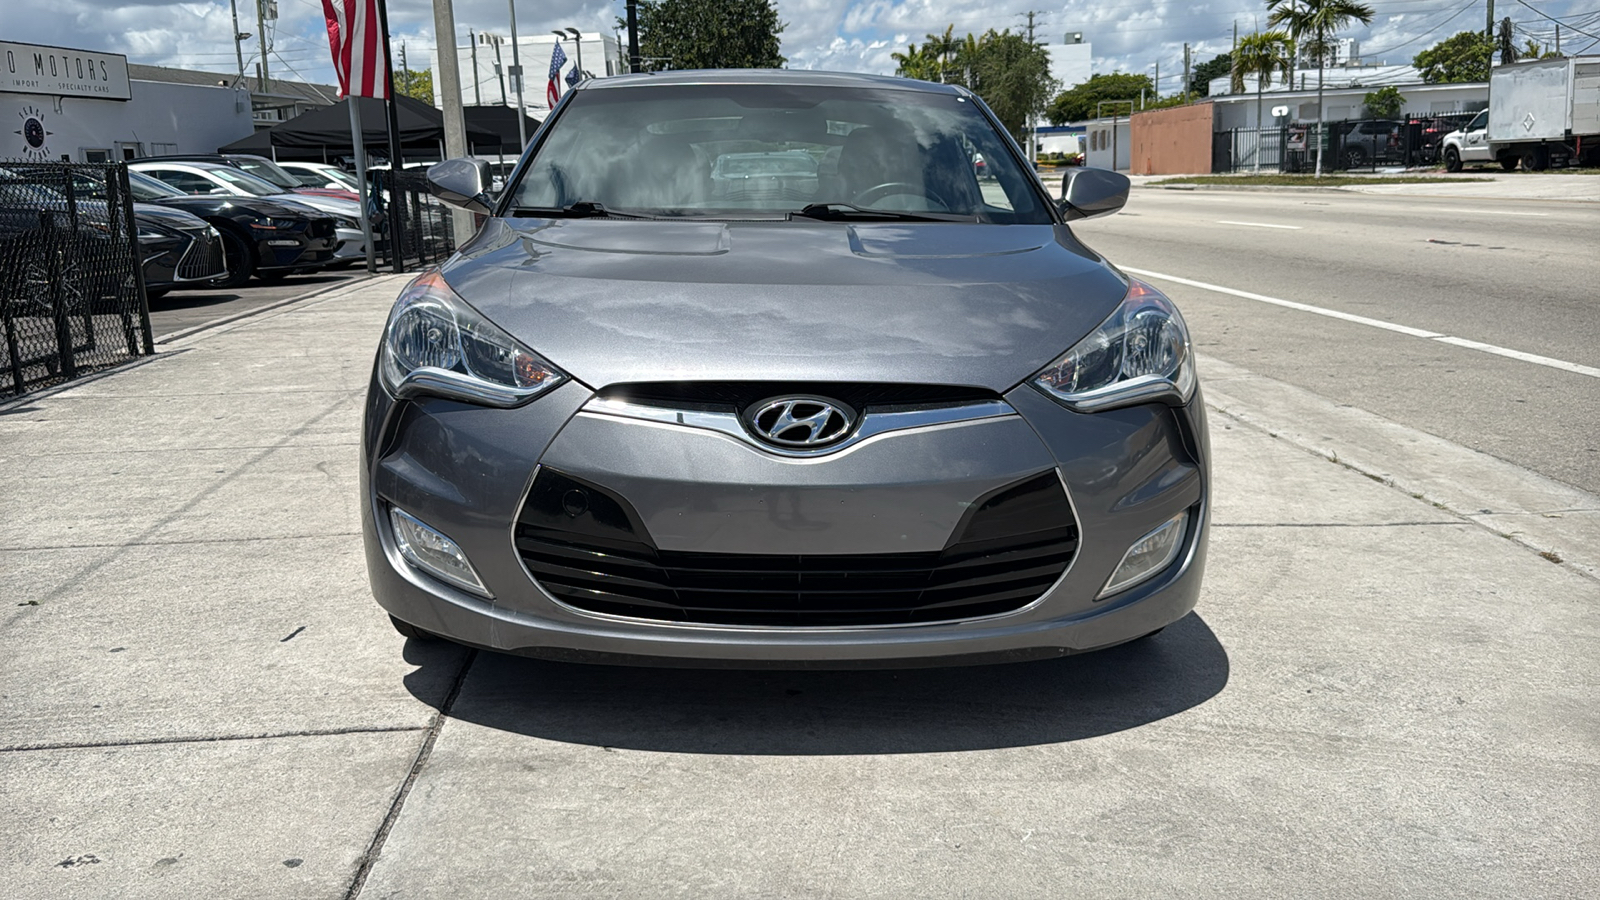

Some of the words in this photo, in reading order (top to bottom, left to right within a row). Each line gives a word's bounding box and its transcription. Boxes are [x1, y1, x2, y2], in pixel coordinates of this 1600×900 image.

[7, 50, 16, 74] O
[33, 53, 108, 82] MOTORS
[12, 79, 39, 88] IMPORT
[58, 82, 92, 92] SPECIALTY
[94, 85, 109, 93] CARS
